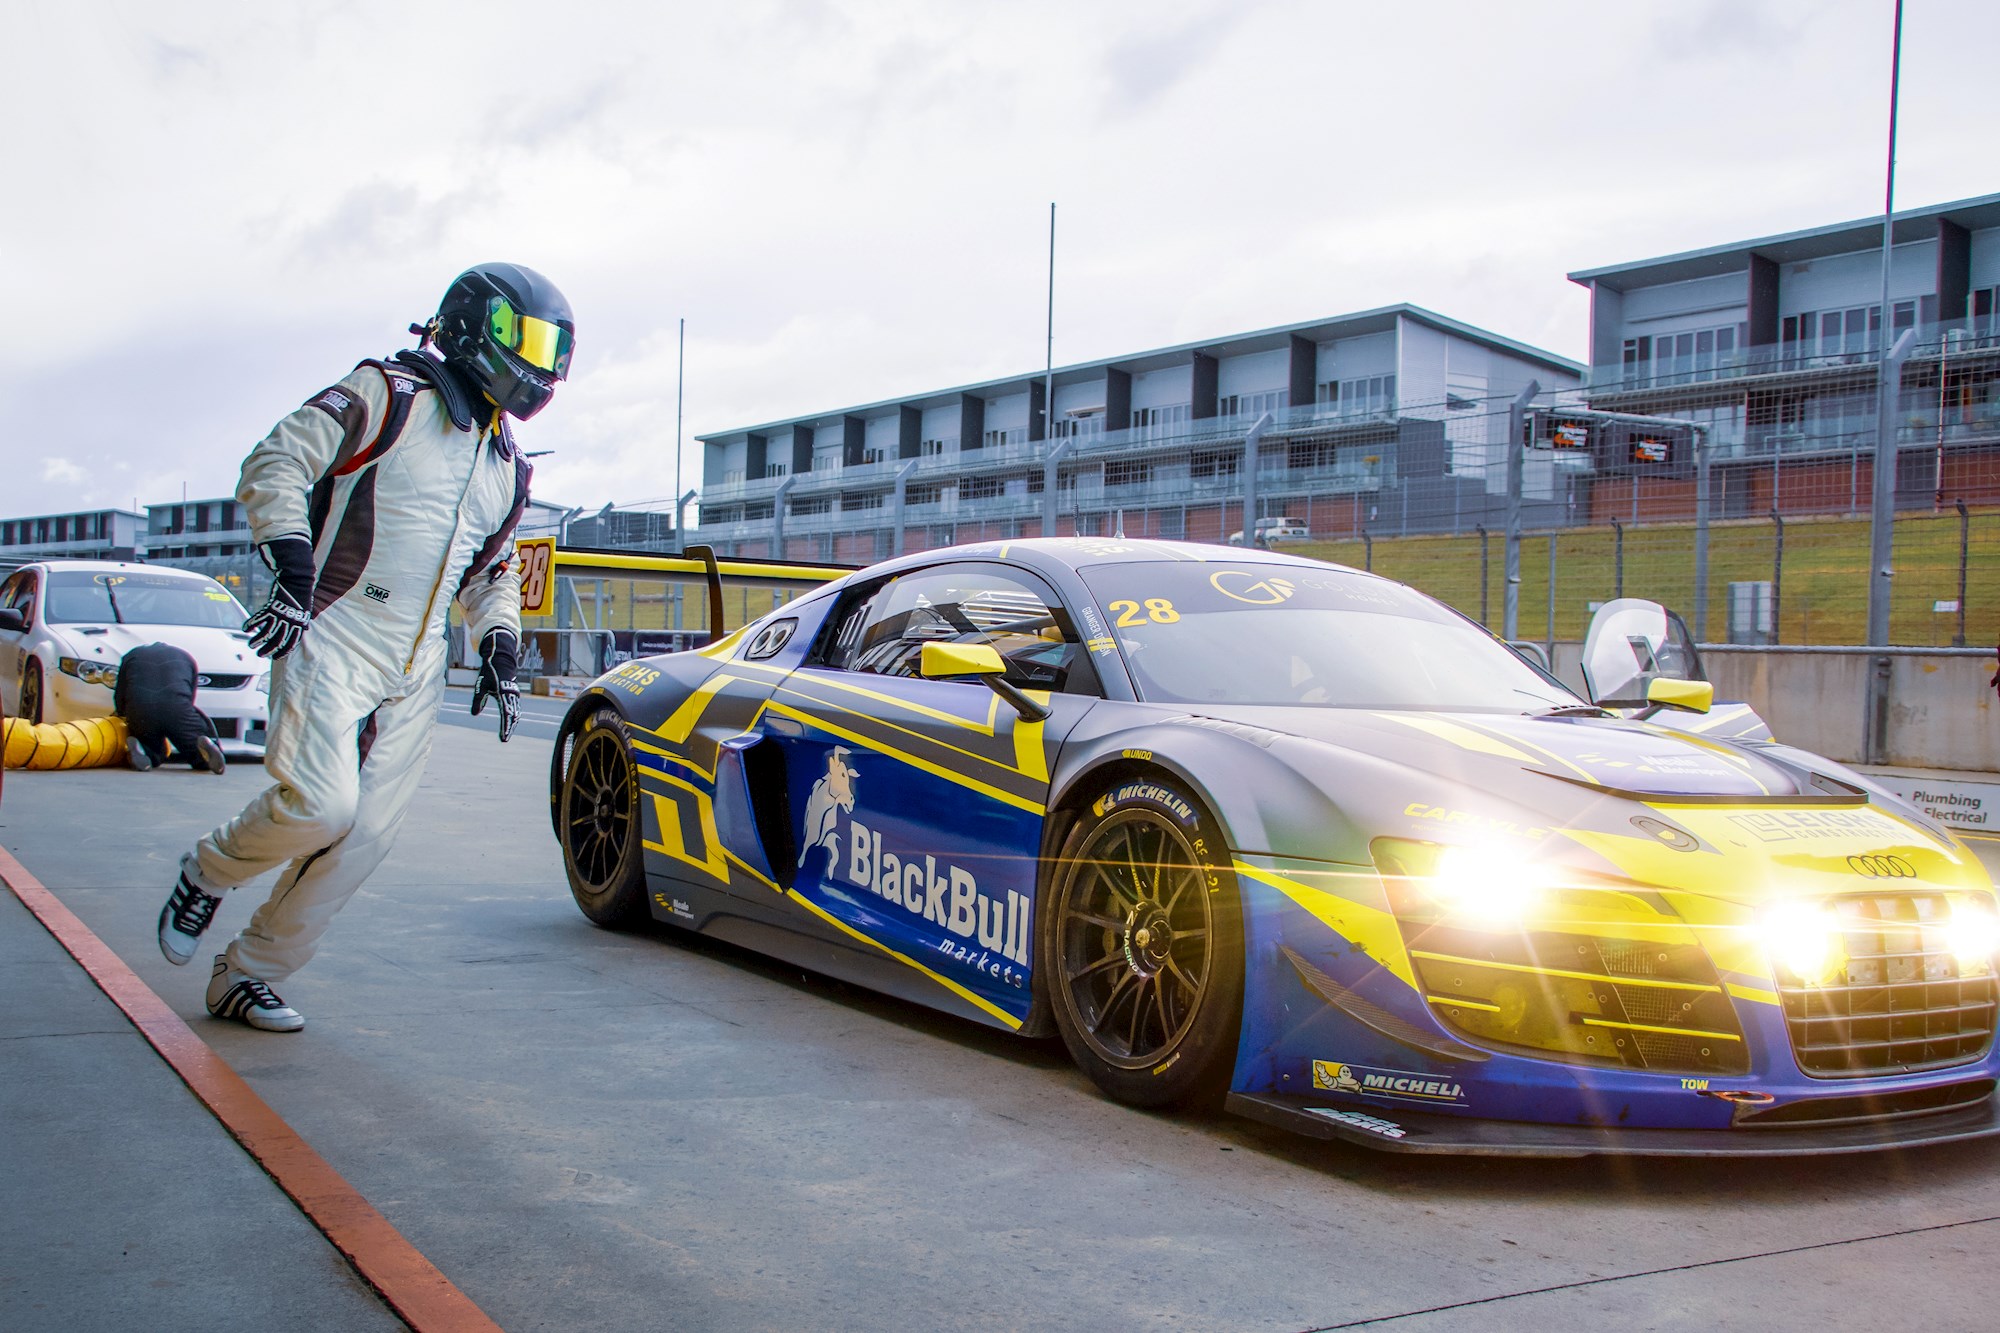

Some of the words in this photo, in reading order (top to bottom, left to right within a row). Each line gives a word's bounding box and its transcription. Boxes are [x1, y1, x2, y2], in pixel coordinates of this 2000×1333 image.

[395, 380, 415, 392] OMP
[322, 392, 349, 409] OMP
[365, 586, 390, 600] OMP
[1108, 598, 1181, 628] 28
[1118, 784, 1193, 820] MICHELIN
[1913, 791, 1981, 809] Plumbing
[849, 820, 1030, 967] BlackBull
[1124, 929, 1139, 972] RACING
[938, 938, 1023, 988] markets
[1363, 1074, 1466, 1097] MICHELI
[1681, 1079, 1709, 1090] TOW
